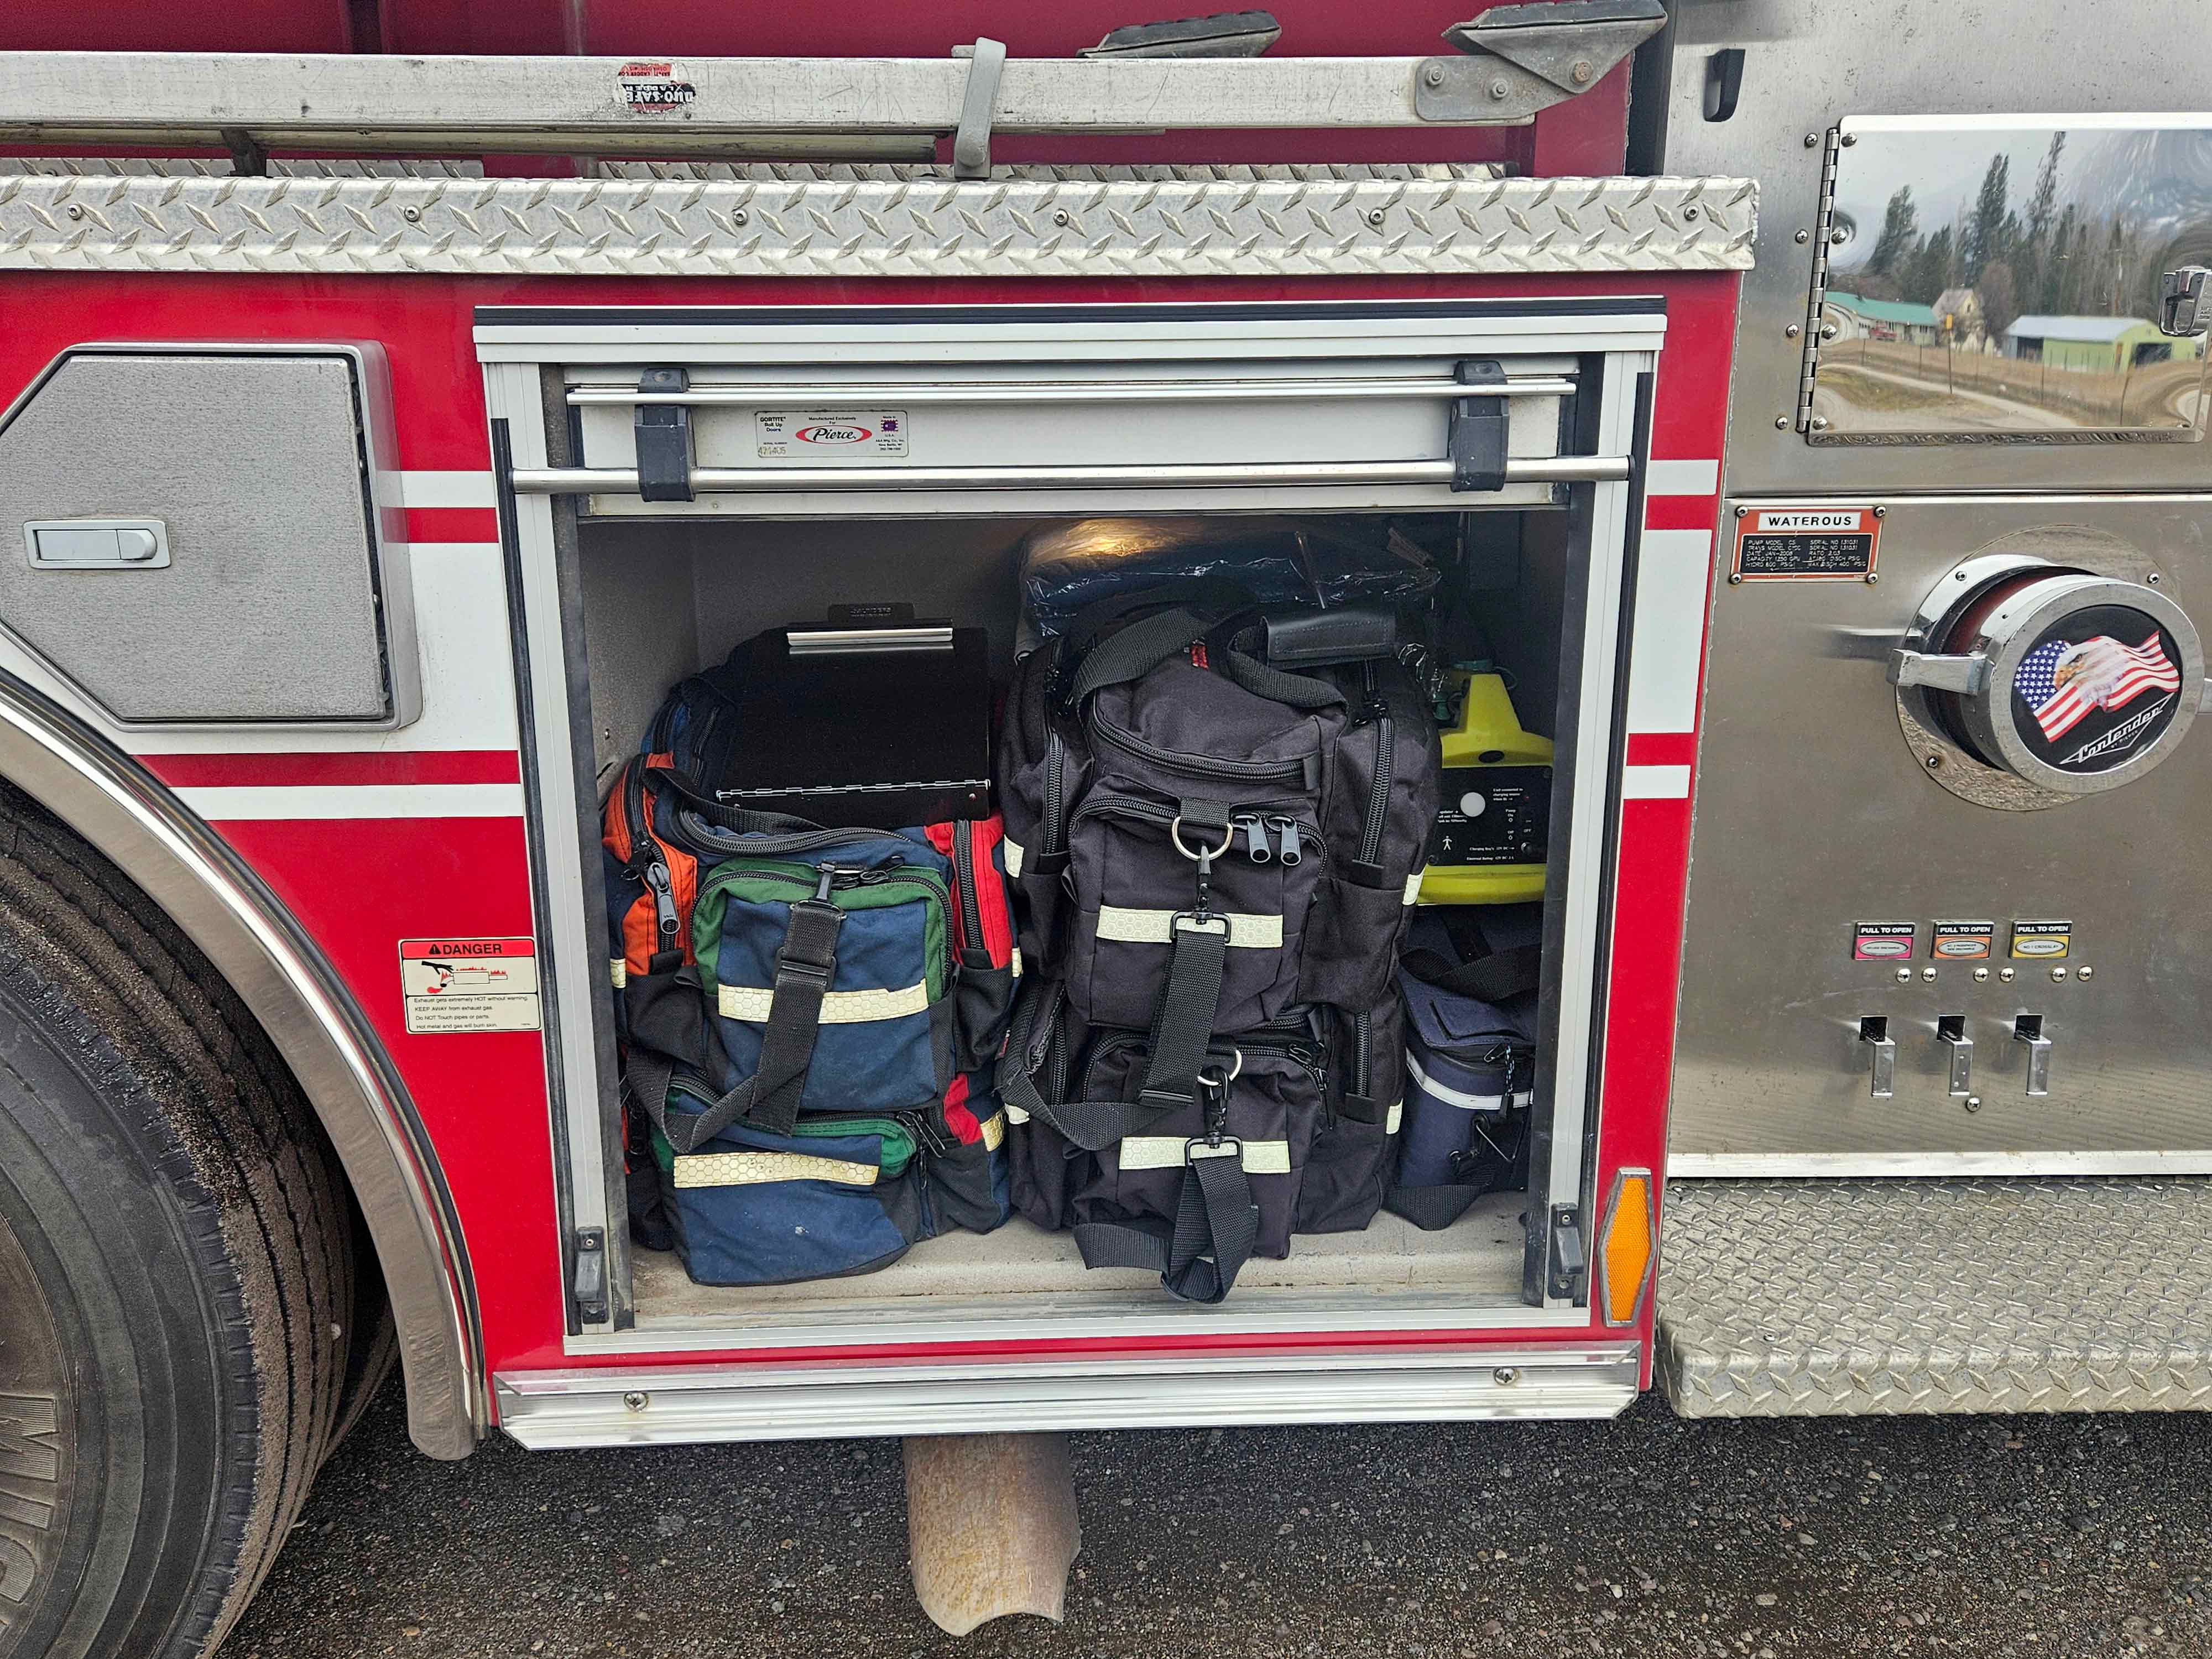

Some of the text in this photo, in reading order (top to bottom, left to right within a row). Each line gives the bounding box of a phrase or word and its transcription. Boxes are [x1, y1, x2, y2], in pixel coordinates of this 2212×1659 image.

[1768, 517, 1852, 526] WATEROUS
[2078, 707, 2163, 763] Contender
[442, 943, 502, 954] DANGER
